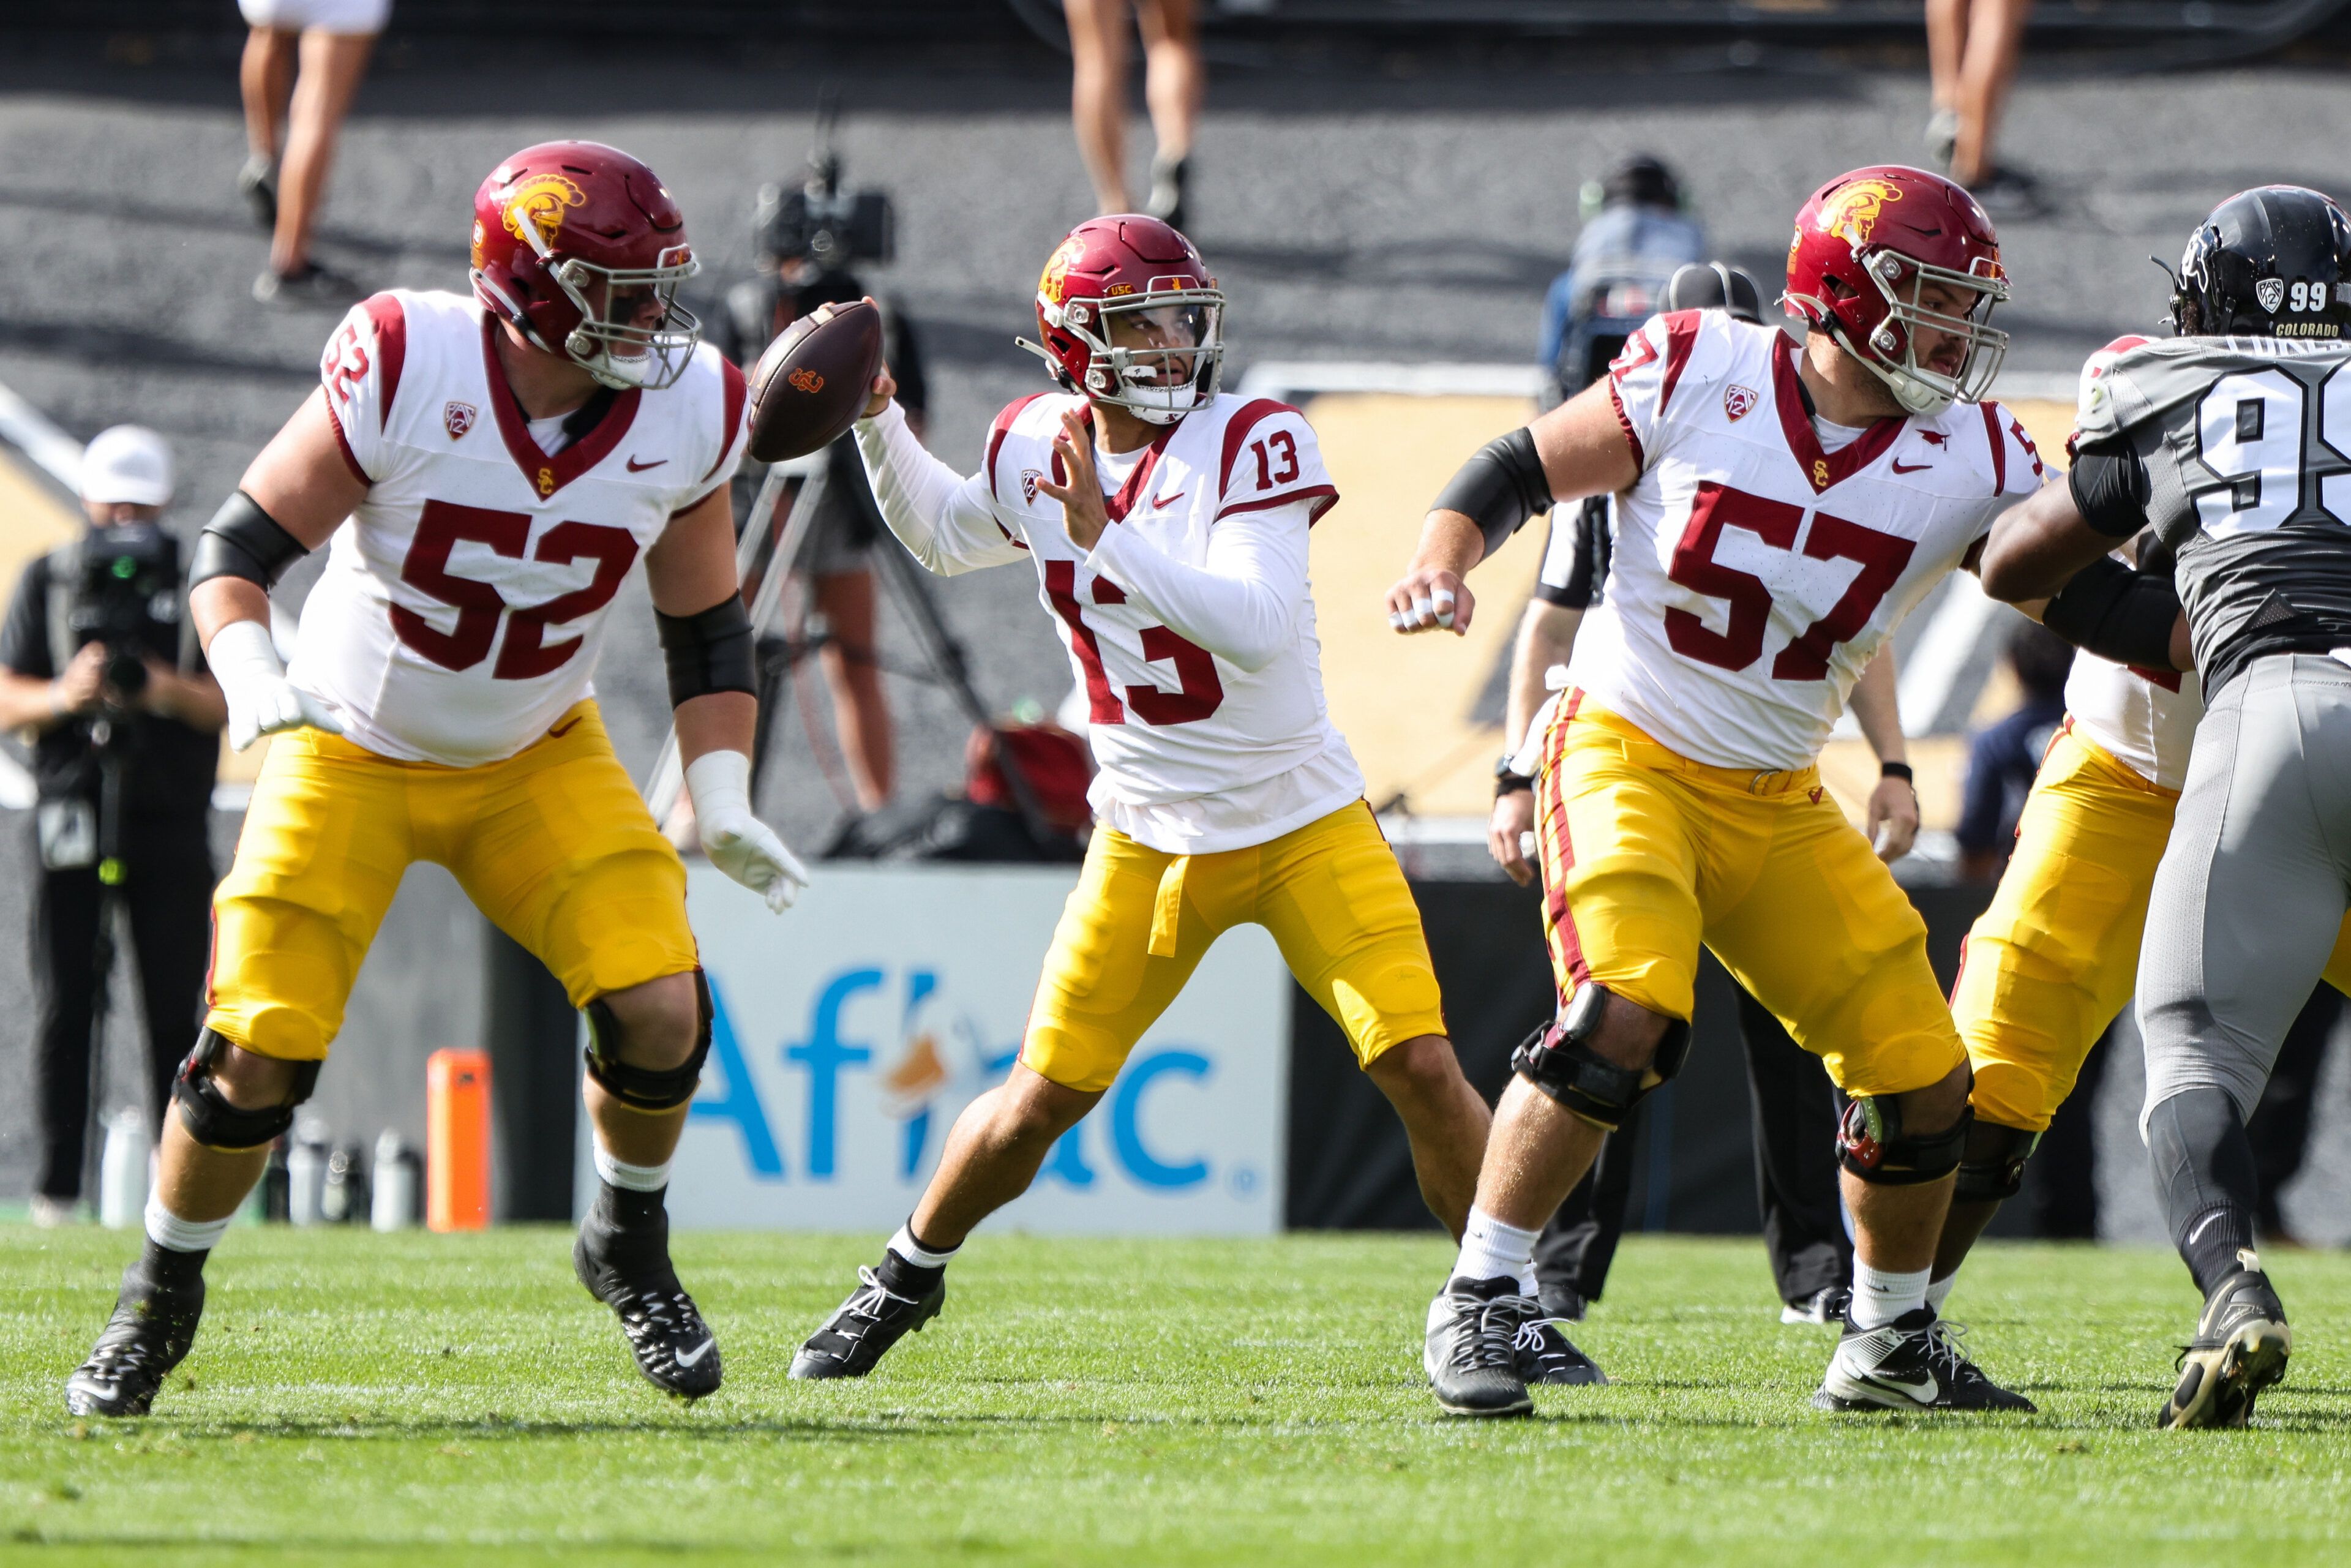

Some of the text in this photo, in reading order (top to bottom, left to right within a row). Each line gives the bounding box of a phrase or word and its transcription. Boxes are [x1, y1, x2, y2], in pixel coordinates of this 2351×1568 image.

[1111, 285, 1133, 296] USC
[2259, 281, 2281, 299] PAC
[2265, 293, 2276, 305] 12
[2290, 282, 2327, 312] 99
[2276, 323, 2339, 337] COLORADO
[324, 322, 370, 407] 52
[1727, 386, 1757, 410] PAC
[1728, 400, 1745, 416] 12
[445, 403, 475, 427] PAC
[449, 418, 464, 434] 12
[1250, 429, 1300, 492] 13
[1026, 484, 1035, 498] 12
[388, 498, 640, 680] 52
[1663, 479, 1918, 681] 57
[1044, 559, 1224, 726] 13
